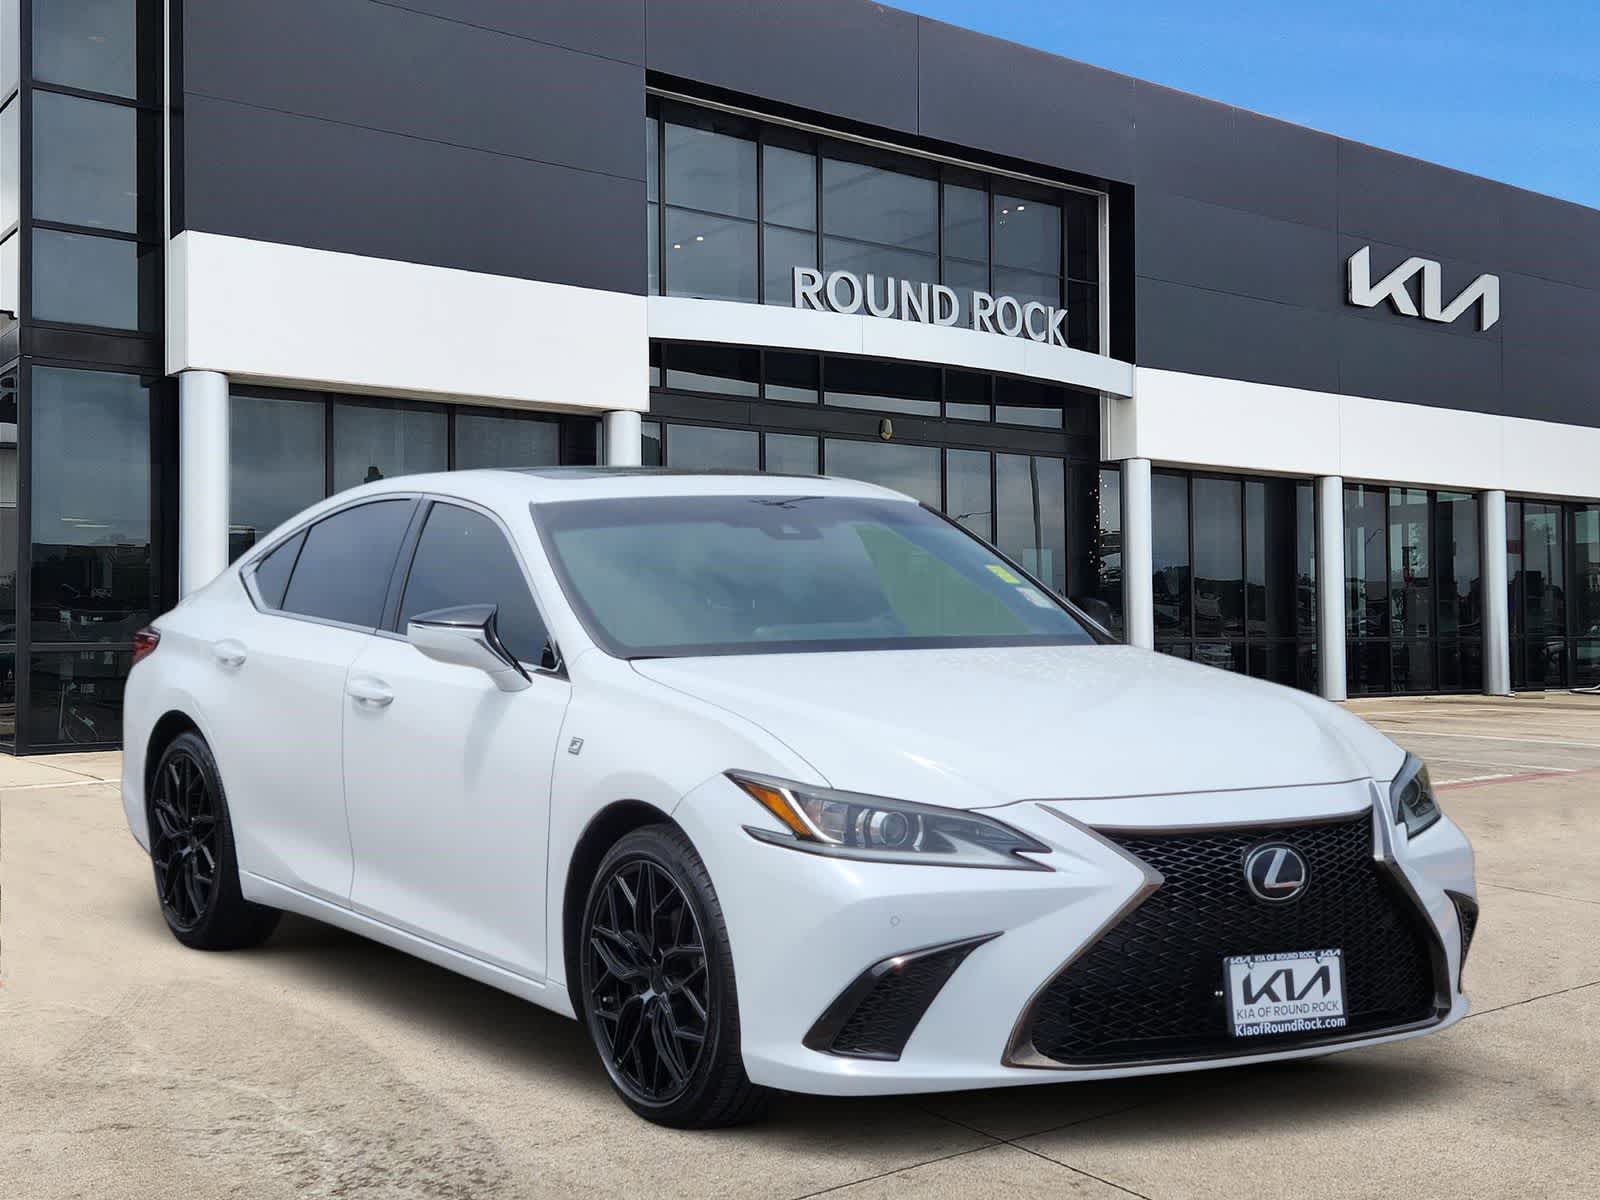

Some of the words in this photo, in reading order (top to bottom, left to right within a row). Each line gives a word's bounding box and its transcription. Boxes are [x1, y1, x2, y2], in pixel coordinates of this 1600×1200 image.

[1348, 245, 1500, 332] KIA
[792, 266, 960, 326] ROUND
[969, 290, 1069, 347] ROCK
[1266, 953, 1275, 961] OF
[1276, 951, 1299, 960] ROUND
[1299, 950, 1317, 959] ROCK
[1242, 965, 1331, 1006] KIA
[1236, 1008, 1256, 1020] KIA
[1257, 1006, 1272, 1018] OF
[1273, 1002, 1310, 1016] ROUND
[1311, 1000, 1340, 1012] ROCK
[1235, 1017, 1346, 1037] KiaofRoundRock.com
